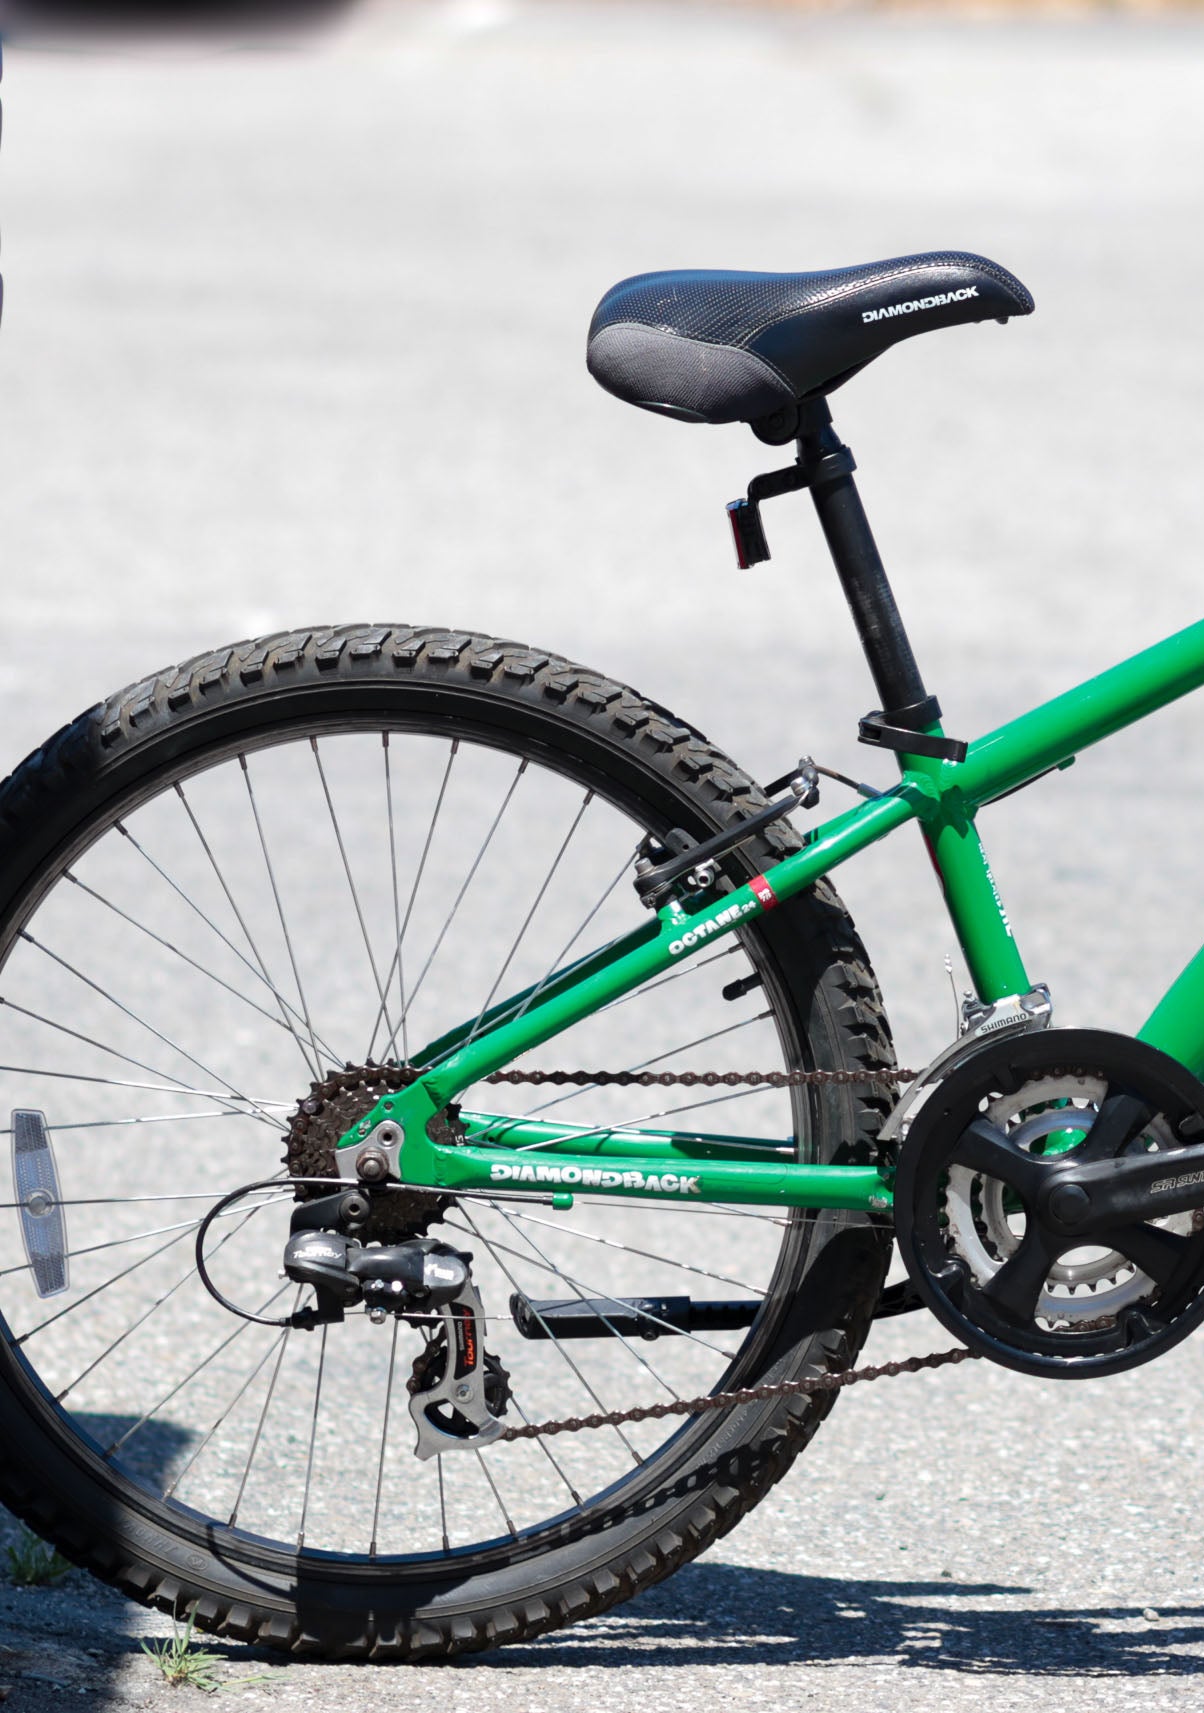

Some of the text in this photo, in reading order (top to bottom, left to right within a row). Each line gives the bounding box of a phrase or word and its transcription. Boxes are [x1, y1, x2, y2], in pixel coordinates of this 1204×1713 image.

[862, 286, 979, 323] DIAMONDBACK
[668, 904, 742, 955] OCTANE
[981, 1012, 1027, 1034] SHIMANO
[490, 1164, 702, 1194] DIAMONDBACK
[1150, 1177, 1176, 1194] SR
